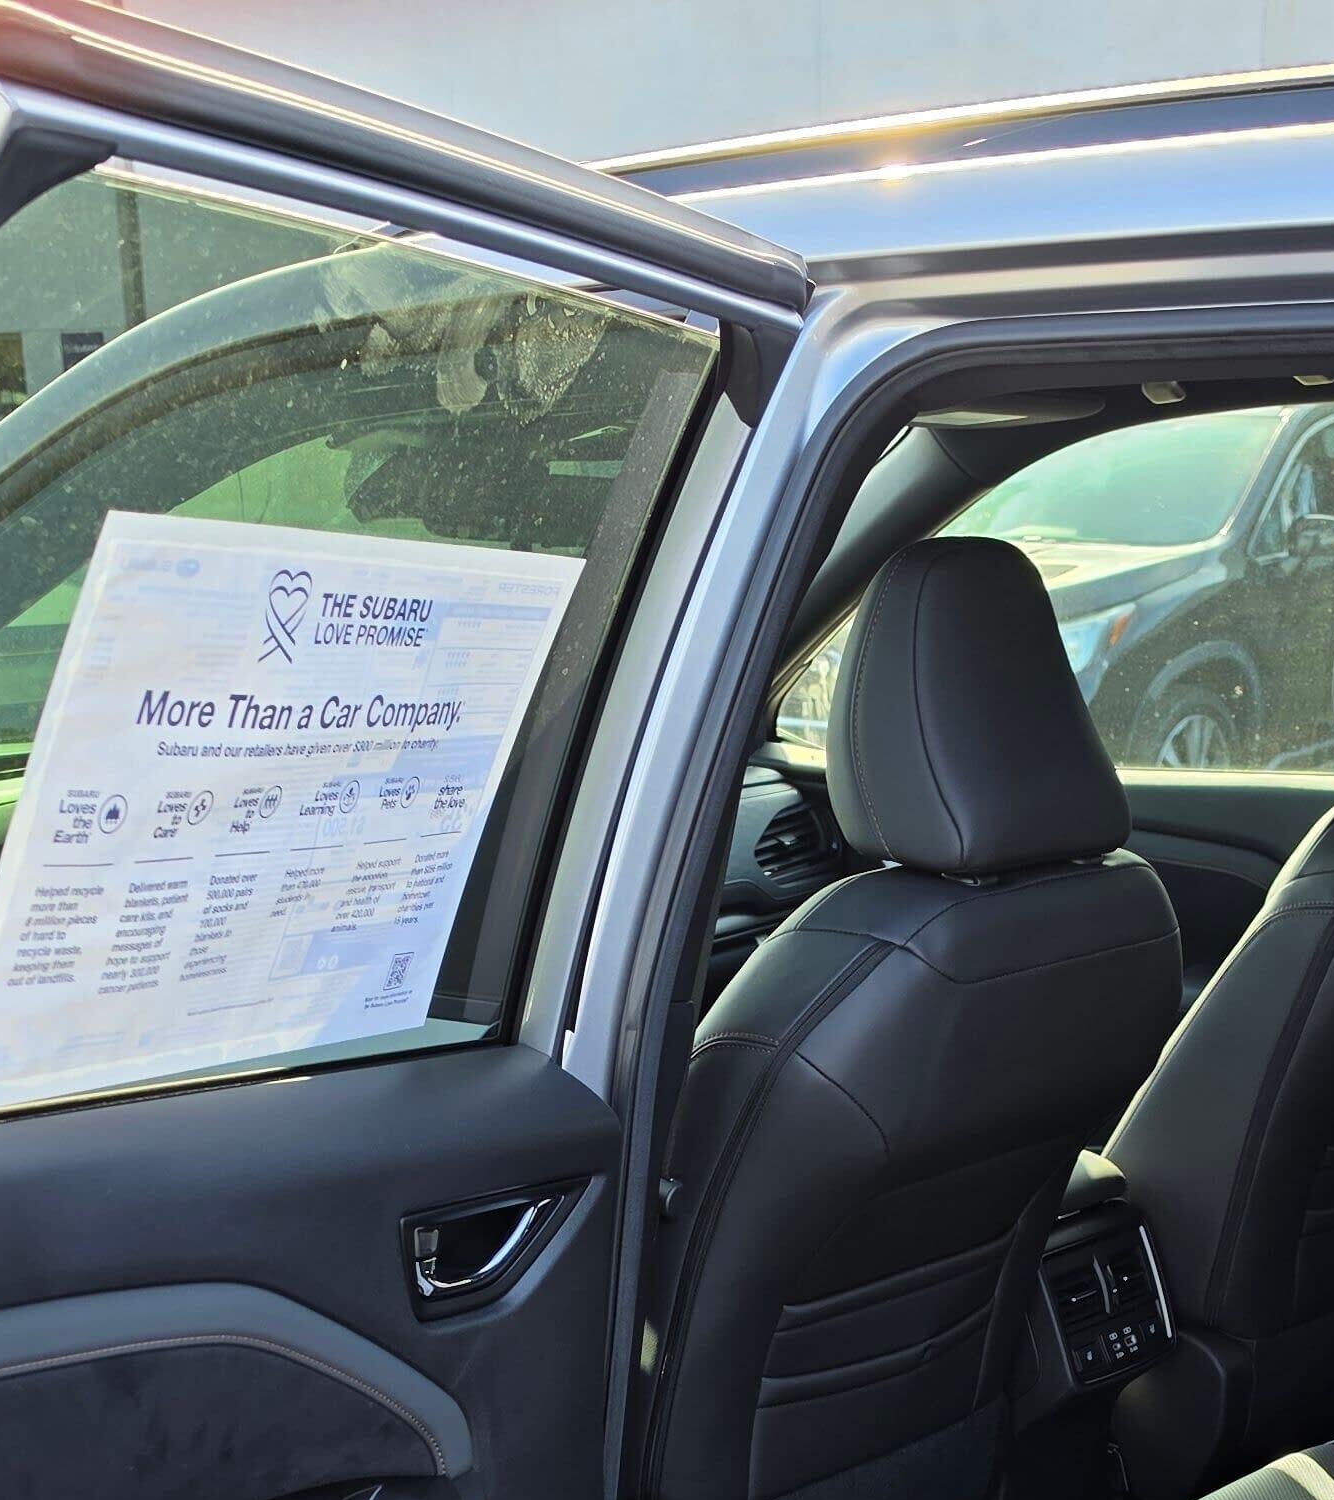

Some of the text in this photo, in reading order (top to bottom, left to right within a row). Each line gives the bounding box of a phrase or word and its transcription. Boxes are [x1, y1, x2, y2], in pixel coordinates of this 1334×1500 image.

[320, 593, 435, 623] THE SUBARU
[314, 623, 424, 647] LOVE PROMISE
[136, 690, 463, 733] More Than a Car Company.
[156, 741, 200, 758] Subaru
[201, 742, 222, 757] and
[224, 745, 241, 757] our
[244, 743, 283, 757] retailers
[284, 742, 307, 756] have
[307, 742, 332, 758] given
[332, 743, 353, 753] over
[314, 789, 339, 803] Loves
[379, 786, 402, 799] Loves
[438, 785, 464, 797] share
[59, 800, 97, 814] Loves
[157, 800, 187, 814] Loves
[234, 797, 259, 809] Loves
[381, 799, 397, 810] Pets
[434, 797, 466, 810] the love
[246, 810, 255, 819] to
[299, 804, 336, 818] Learning
[72, 817, 93, 829] the
[171, 815, 183, 826] to
[153, 827, 178, 839] Care
[229, 821, 250, 835] Help
[53, 831, 90, 844] Earth
[209, 874, 240, 886] Donated
[35, 887, 70, 899] Helped
[128, 881, 166, 894] Delivered
[30, 901, 79, 912] more than
[67, 915, 98, 928] pieces
[19, 931, 31, 941] of
